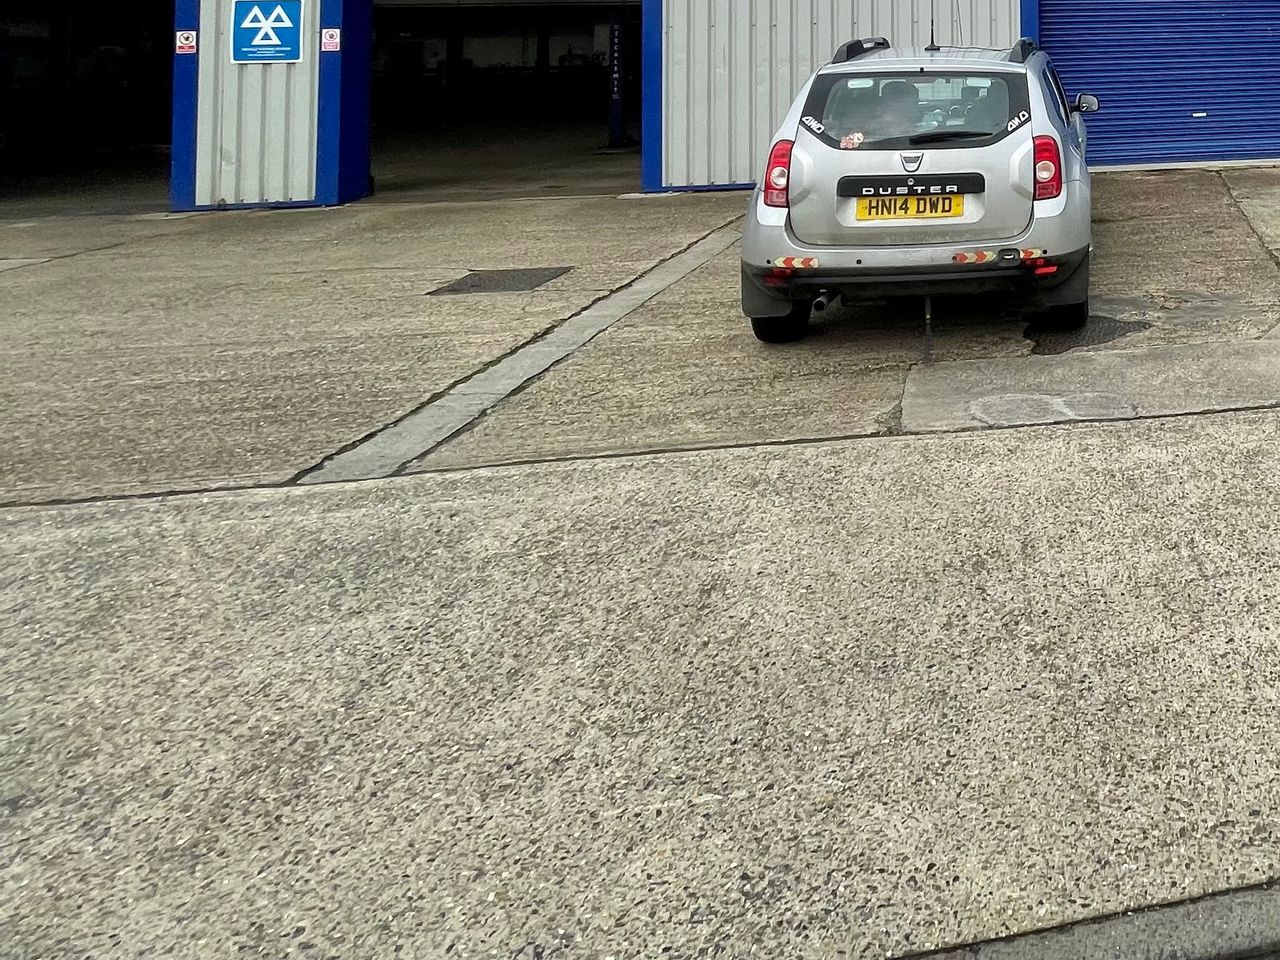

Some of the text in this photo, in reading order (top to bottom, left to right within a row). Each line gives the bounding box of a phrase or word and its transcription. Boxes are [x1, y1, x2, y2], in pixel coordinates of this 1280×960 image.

[801, 116, 825, 134] 4WD
[862, 185, 958, 195] DUSTER
[867, 197, 953, 216] HN14 DWD
